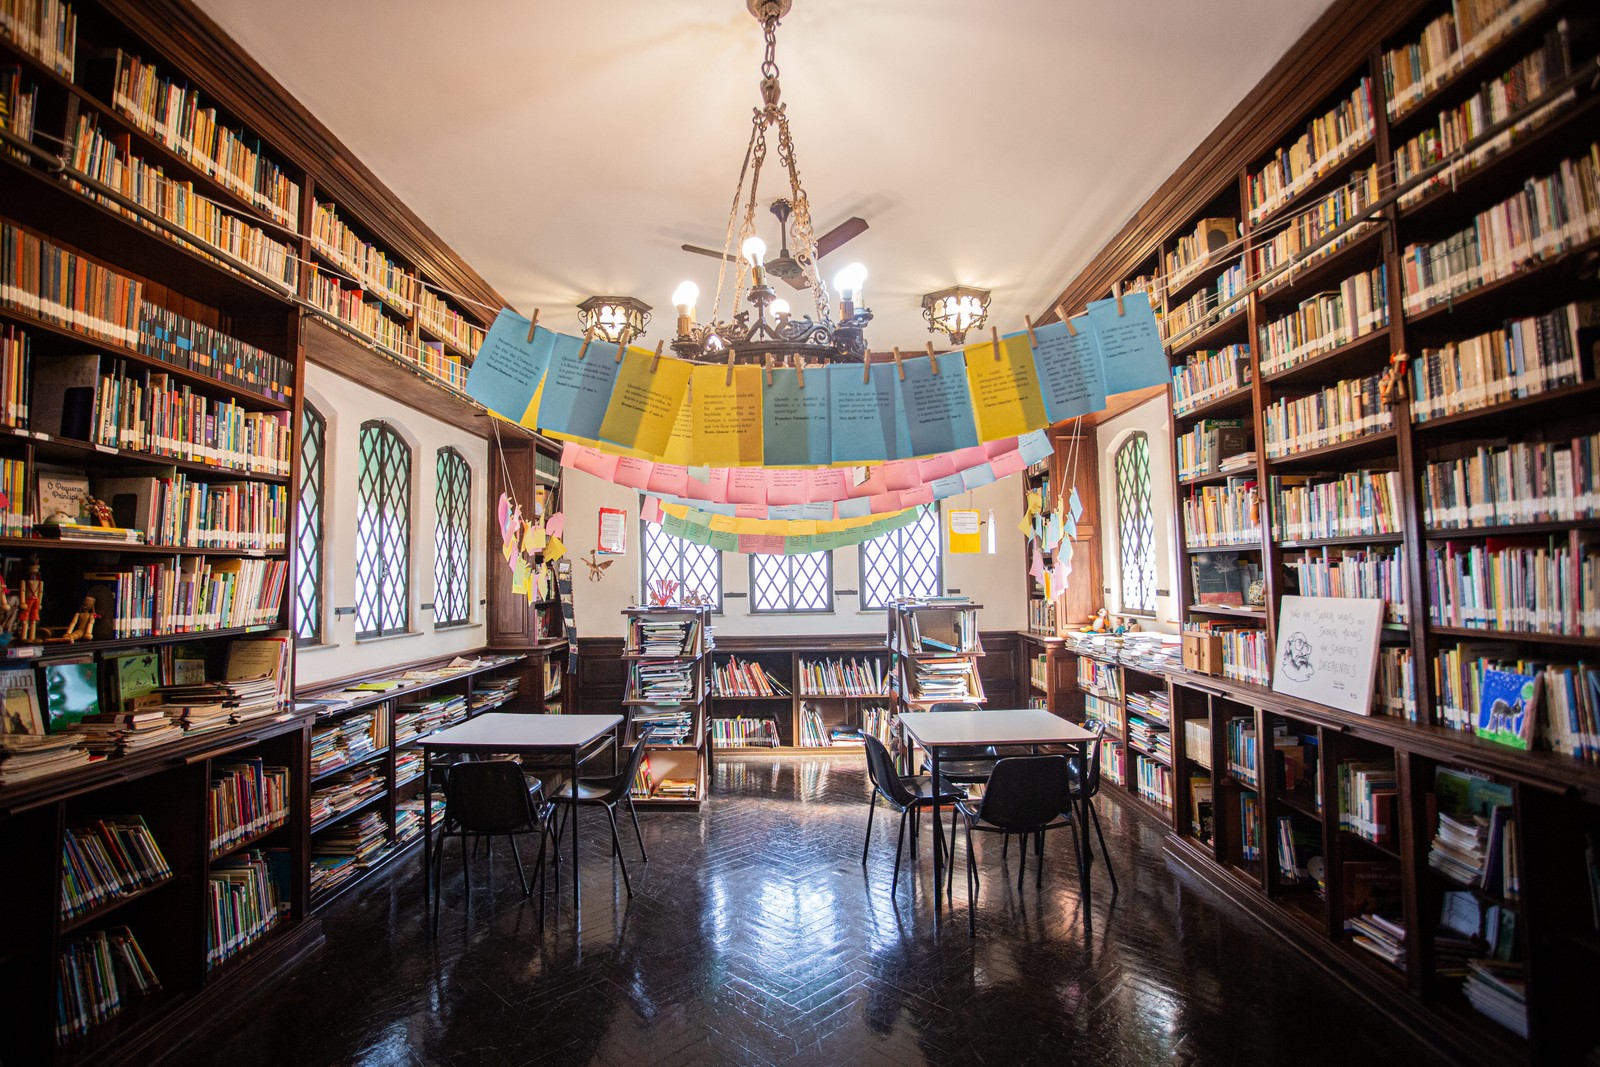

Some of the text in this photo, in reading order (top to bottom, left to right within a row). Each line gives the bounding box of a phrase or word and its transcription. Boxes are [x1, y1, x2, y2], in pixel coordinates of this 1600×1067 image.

[47, 481, 83, 495] O Pequeno
[1313, 608, 1334, 624] SABER
[1338, 612, 1354, 625] MAIS
[1317, 626, 1338, 639] SABER
[1327, 644, 1358, 658] SABERES
[1317, 659, 1356, 678] DIFERENTES
